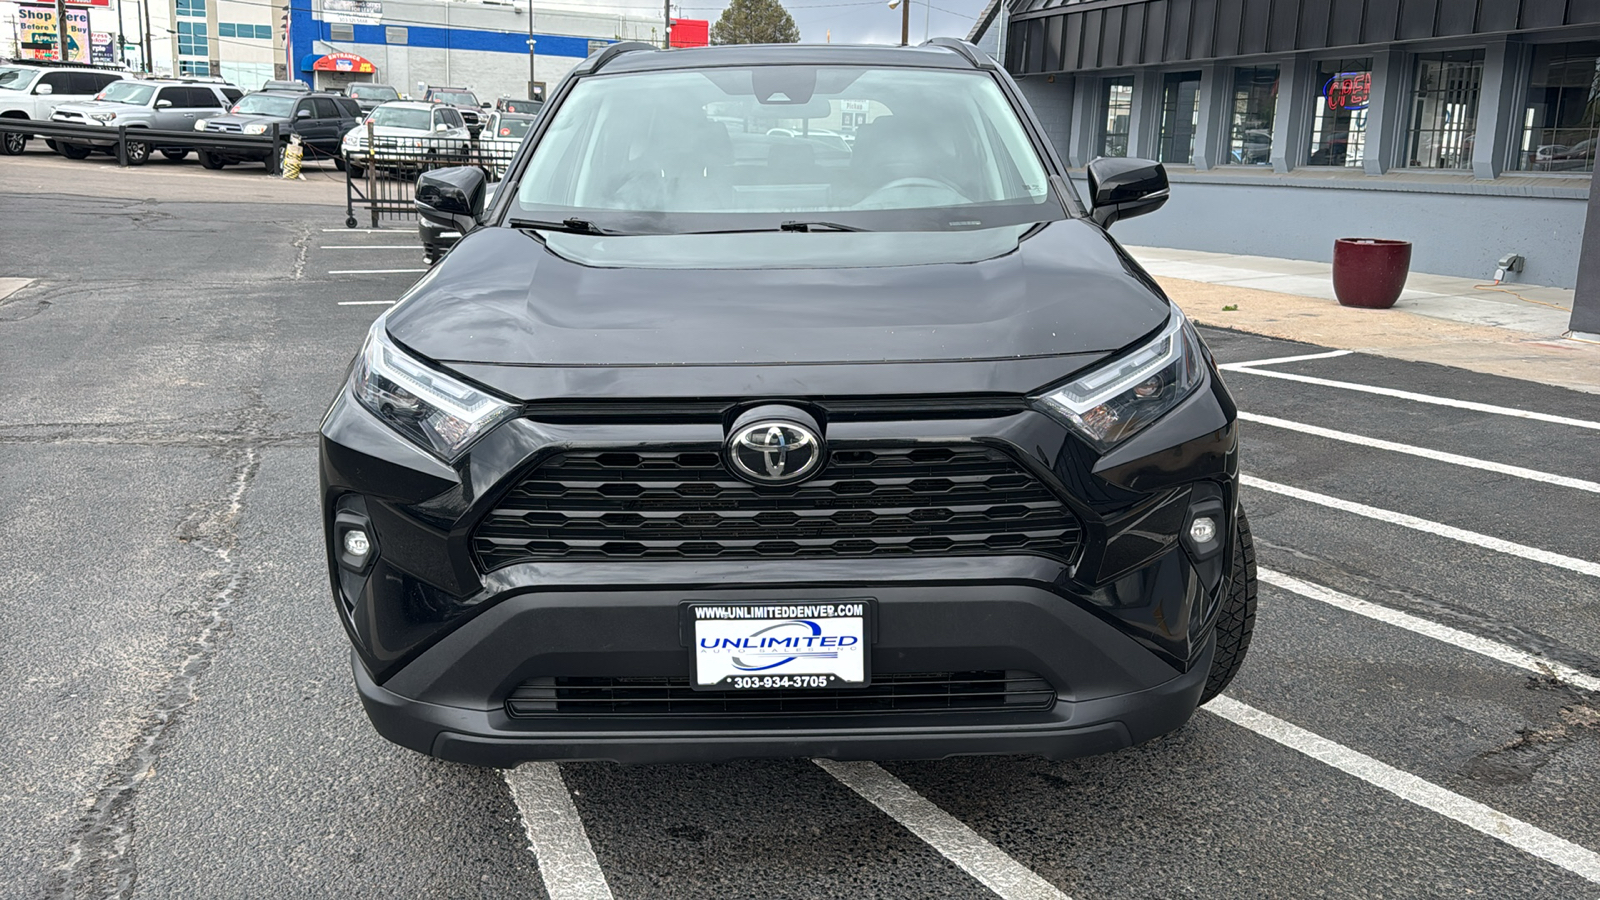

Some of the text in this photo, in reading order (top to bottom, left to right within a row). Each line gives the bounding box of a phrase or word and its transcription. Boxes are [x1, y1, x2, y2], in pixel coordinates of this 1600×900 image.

[19, 9, 87, 22] Shop ere
[20, 23, 49, 31] Before
[71, 26, 87, 34] Buy
[327, 53, 361, 62] ENTRANCE
[695, 604, 863, 619] WWW.UNLIMITEDDENVER.COM
[700, 635, 858, 649] UNLIMITED
[734, 676, 827, 689] 303-934-3705
